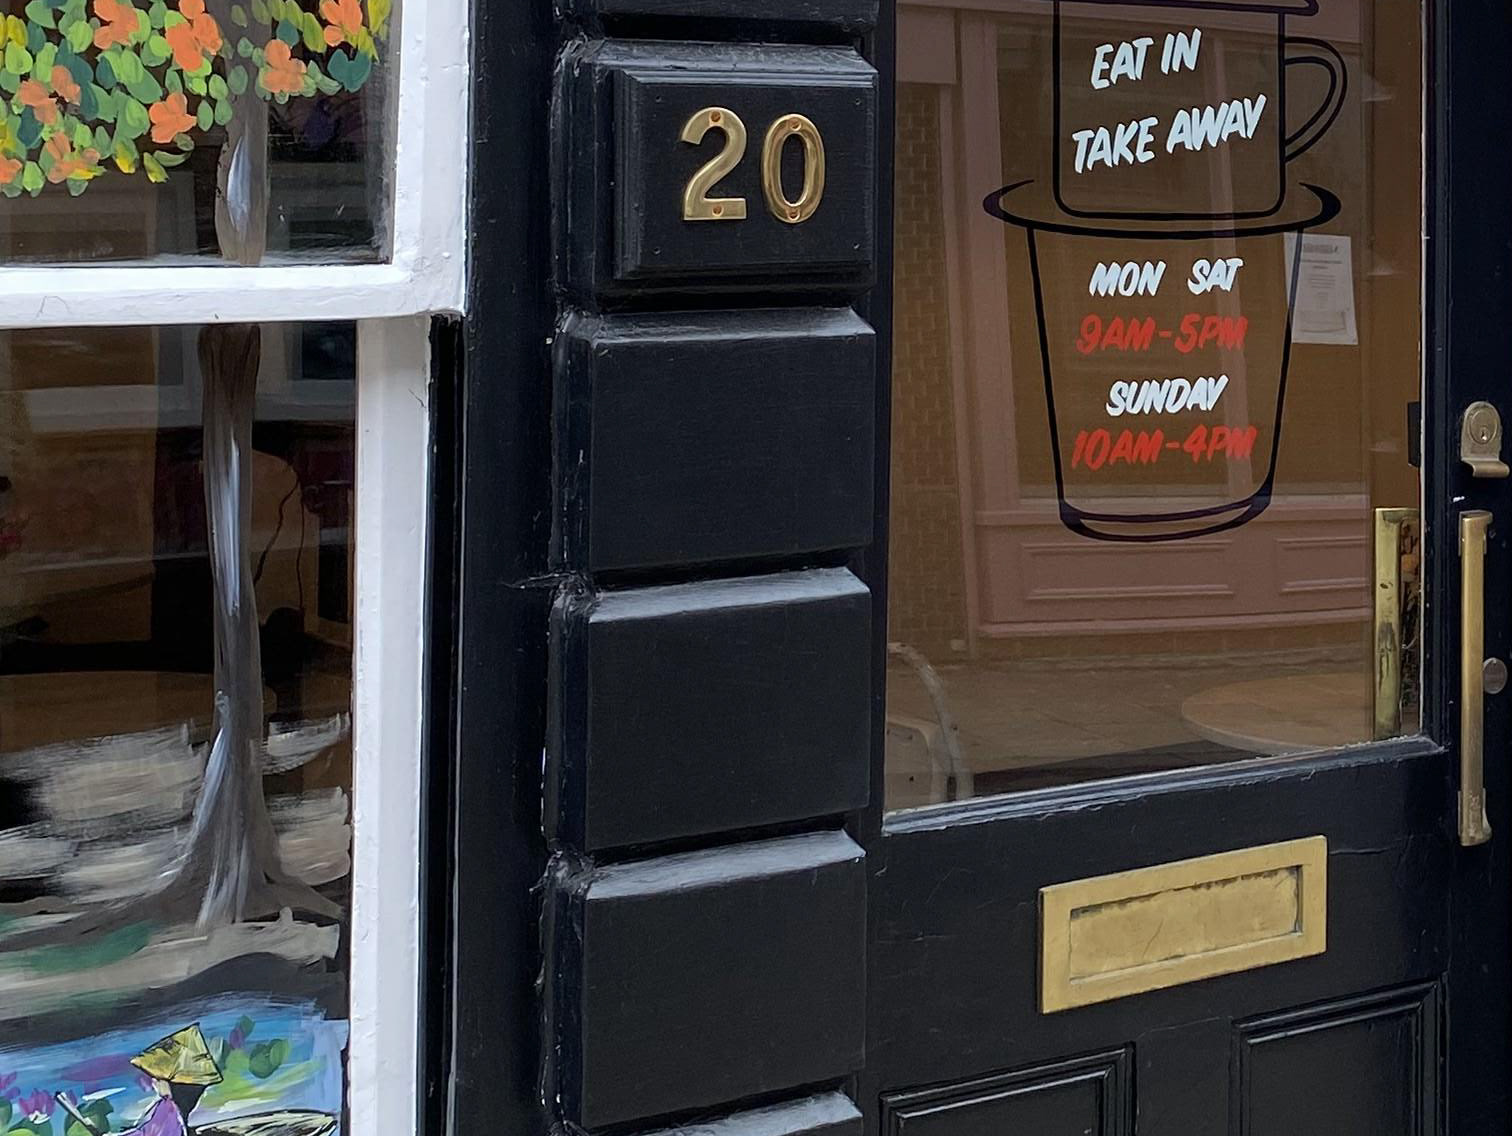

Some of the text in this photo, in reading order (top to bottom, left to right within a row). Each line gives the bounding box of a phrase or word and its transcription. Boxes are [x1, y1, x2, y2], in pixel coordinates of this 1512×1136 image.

[1089, 28, 1202, 90] EAT IN
[680, 106, 826, 224] 20
[1071, 94, 1267, 174] TAKE AWAY
[1088, 257, 1244, 297] MON SAT
[1105, 374, 1229, 417] SUNDAY
